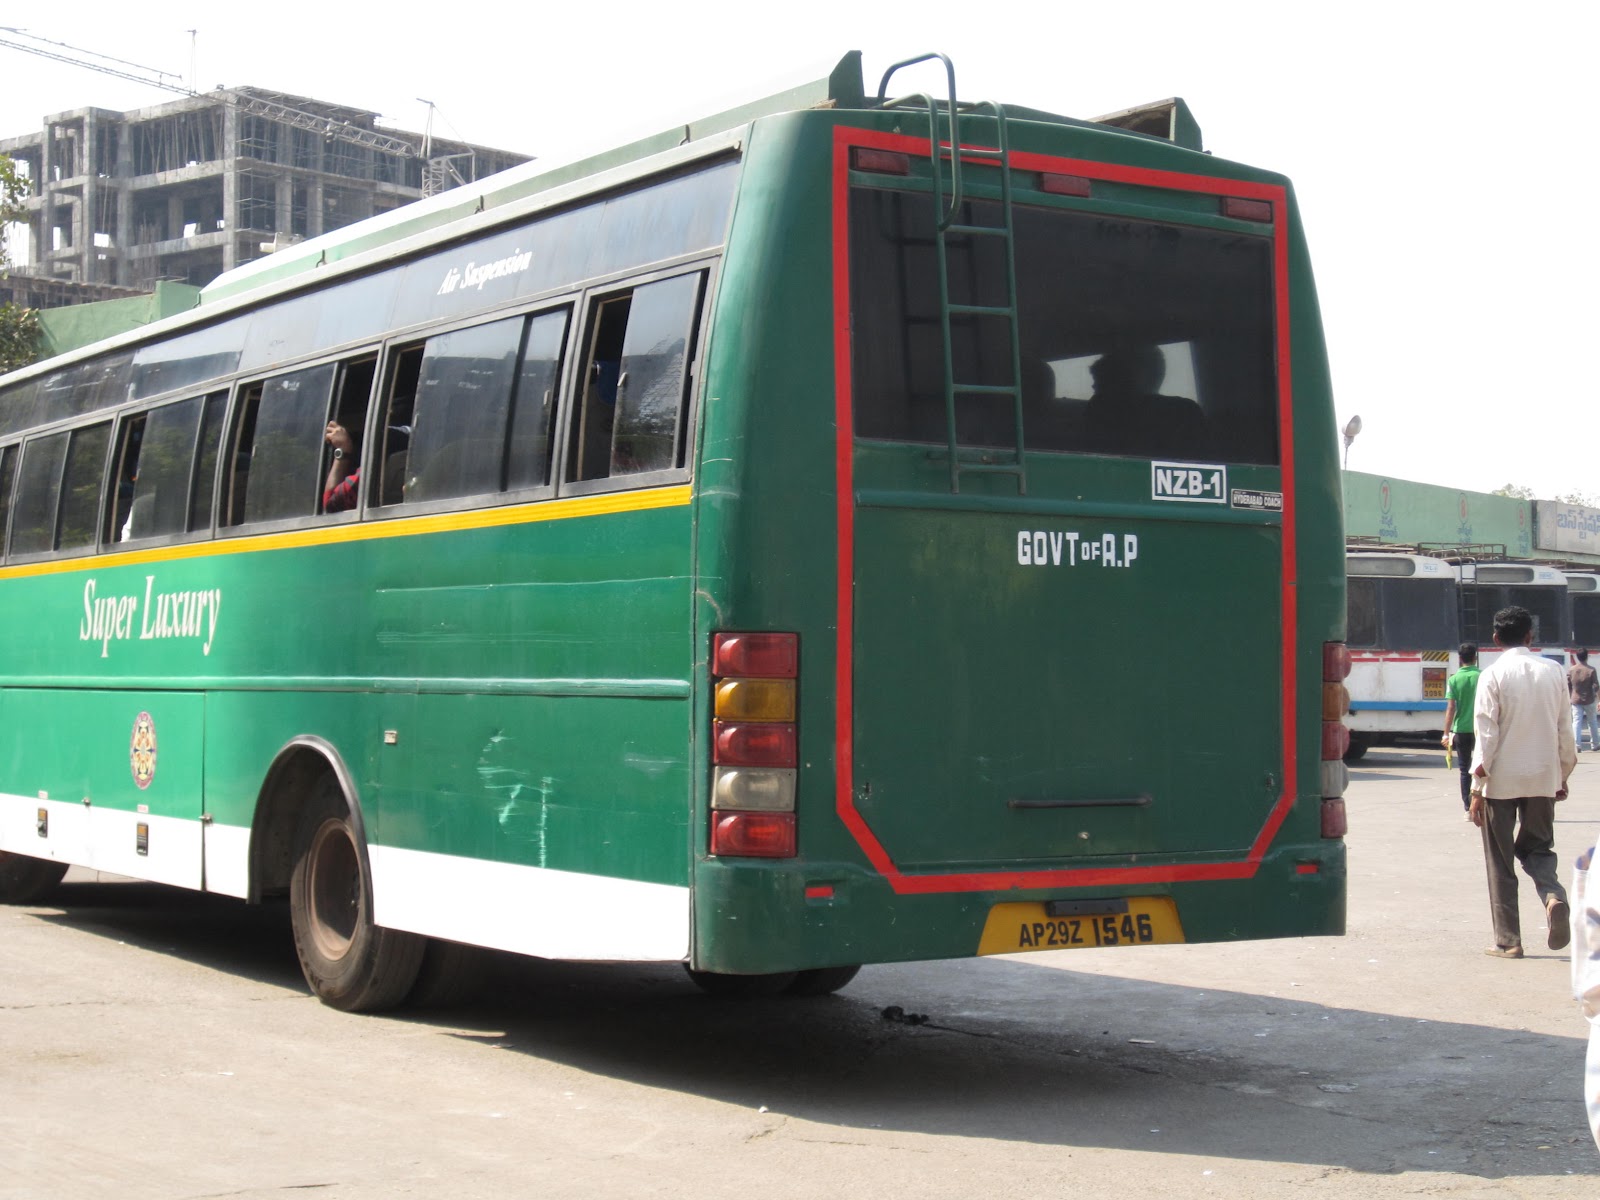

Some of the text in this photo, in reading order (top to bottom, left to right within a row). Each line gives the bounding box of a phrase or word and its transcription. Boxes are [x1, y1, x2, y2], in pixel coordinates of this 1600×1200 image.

[437, 248, 533, 295] Air Suspension
[1155, 468, 1221, 497] NZB-1
[1233, 493, 1281, 507] HYDERABAD COACH
[1017, 530, 1138, 568] GOVT OF A.P
[79, 575, 221, 658] Super Luxury
[1019, 913, 1153, 948] AP29Z 1546
